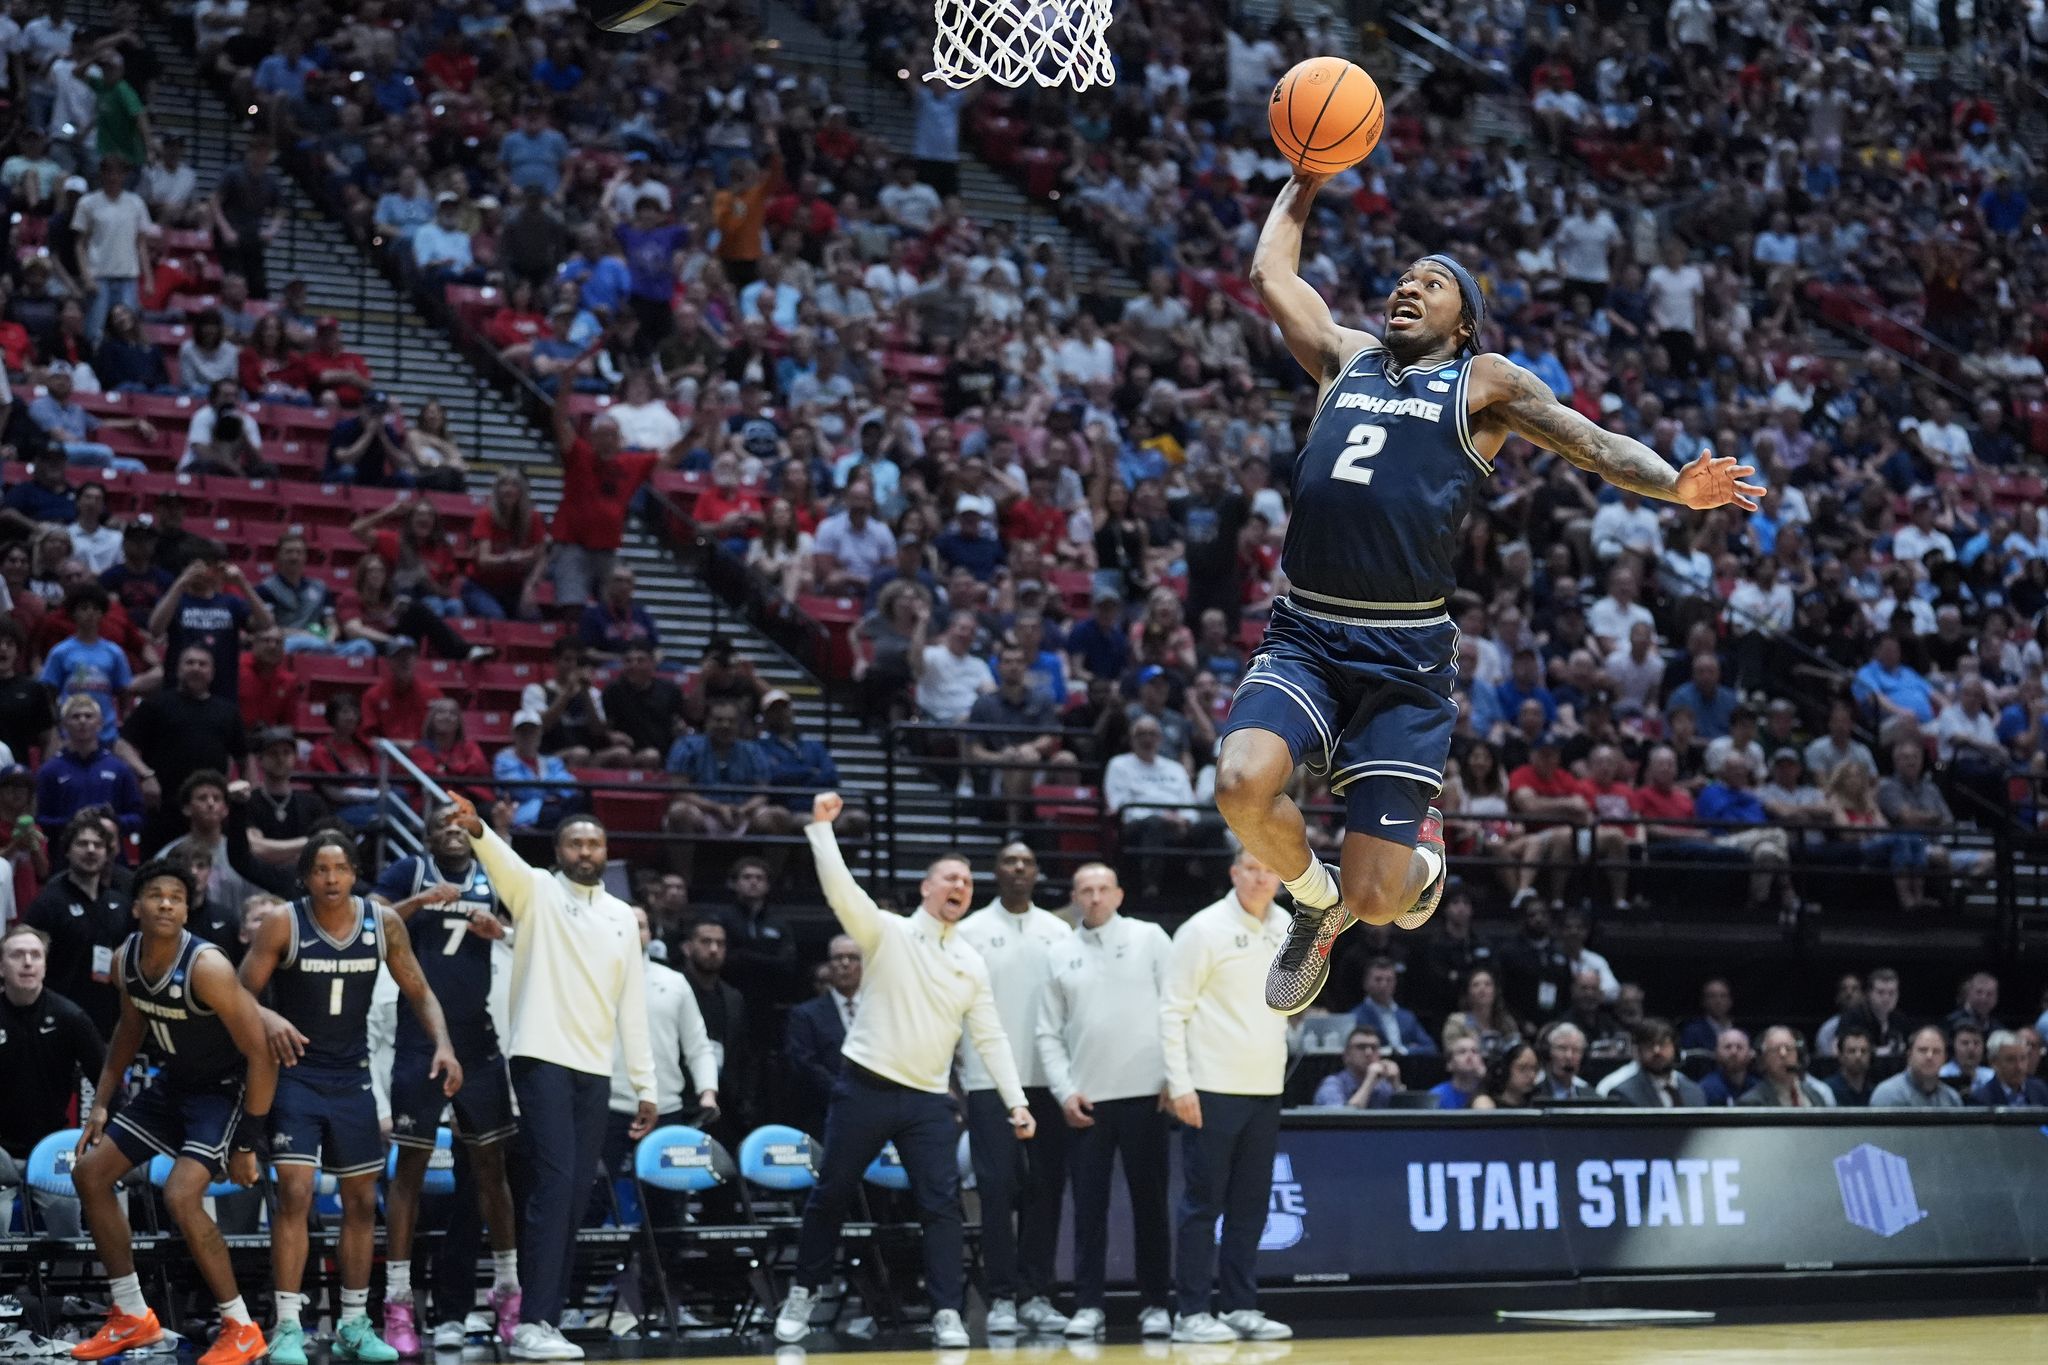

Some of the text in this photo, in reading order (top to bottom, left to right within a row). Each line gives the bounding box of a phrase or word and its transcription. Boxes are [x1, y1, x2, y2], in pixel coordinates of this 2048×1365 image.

[1334, 391, 1443, 423] UTAH STATE
[1330, 423, 1388, 486] 2
[442, 918, 469, 956] 7
[300, 957, 377, 973] UTAH STATE
[328, 978, 344, 1016] 1
[149, 1018, 177, 1056] 11
[1407, 1156, 1745, 1233] UTAH STATE
